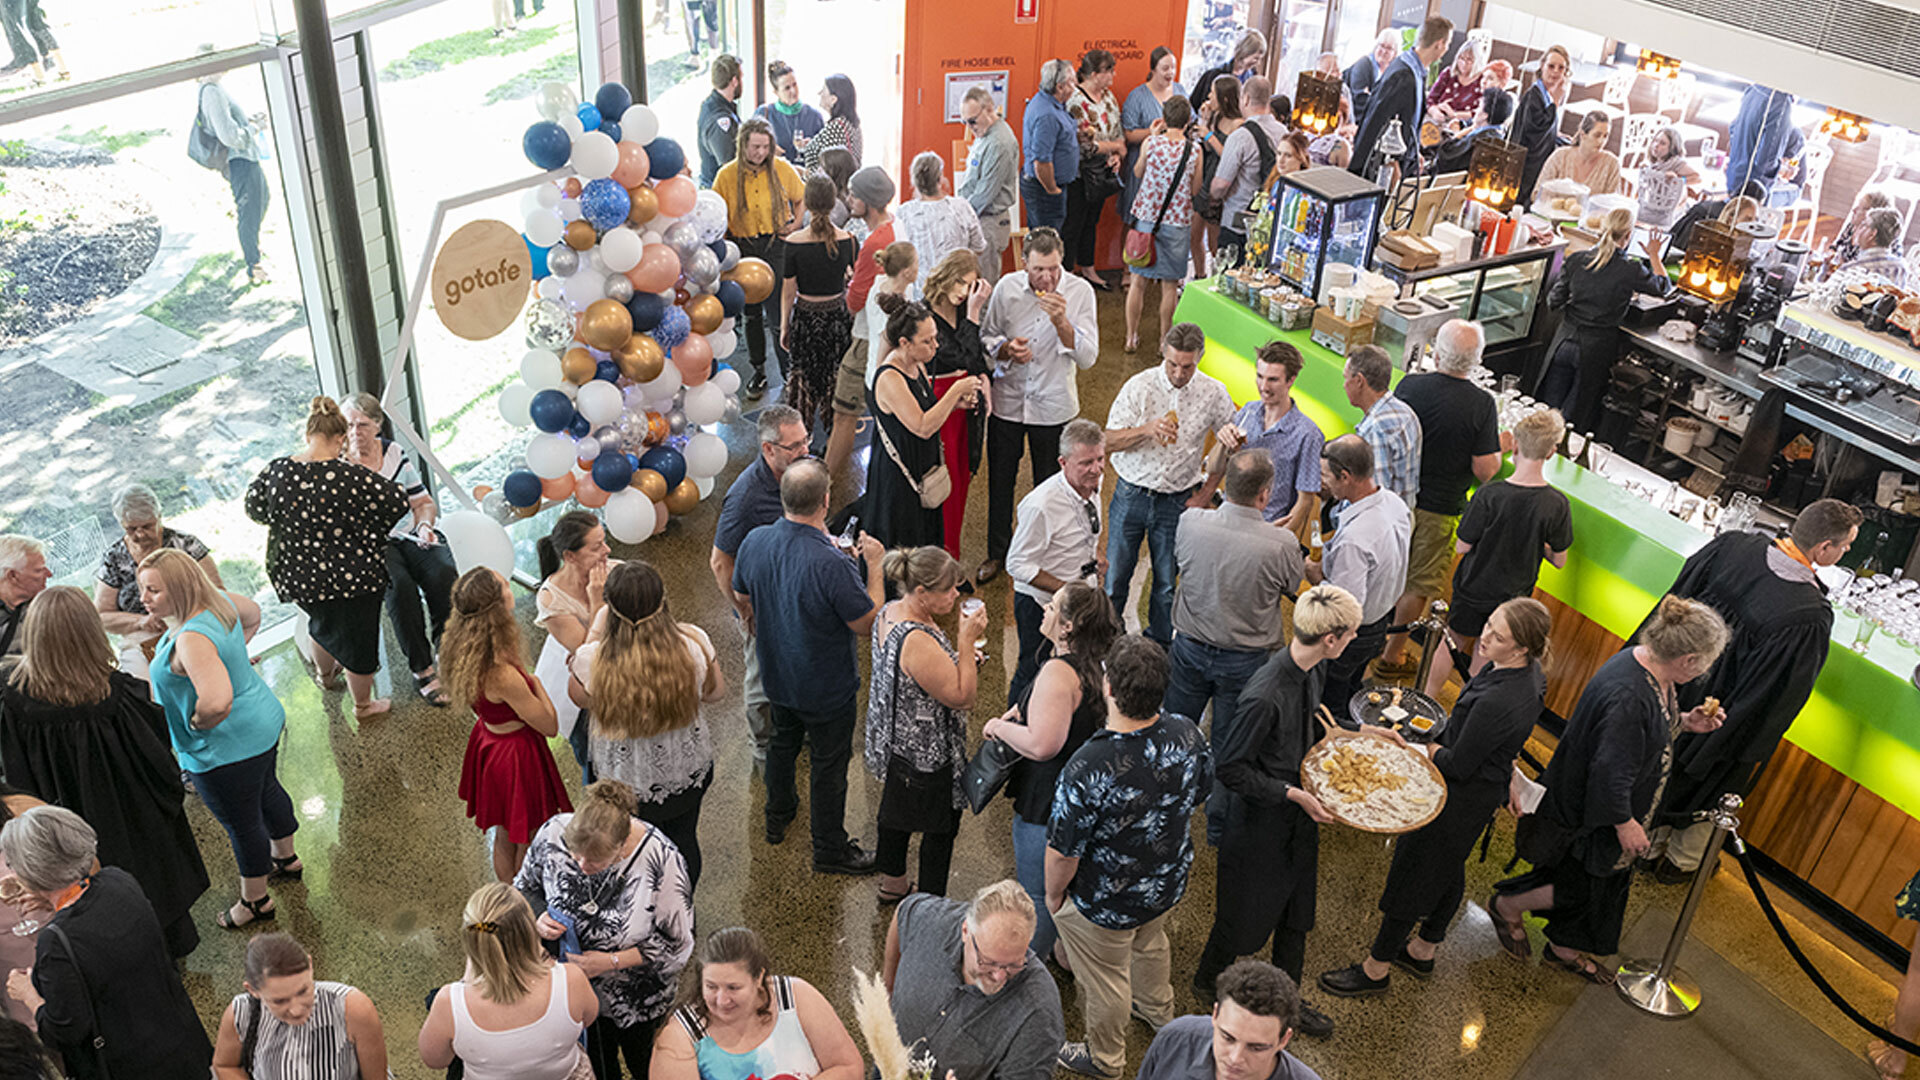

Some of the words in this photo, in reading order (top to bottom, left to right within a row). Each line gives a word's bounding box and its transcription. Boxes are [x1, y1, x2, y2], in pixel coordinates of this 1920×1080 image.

[1083, 39, 1138, 50] ELECTRICAL
[1077, 50, 1145, 61] SBOARD
[941, 58, 961, 68] FIRE
[963, 57, 990, 67] HOSE
[992, 56, 1016, 66] REEL
[445, 258, 520, 306] gotafe
